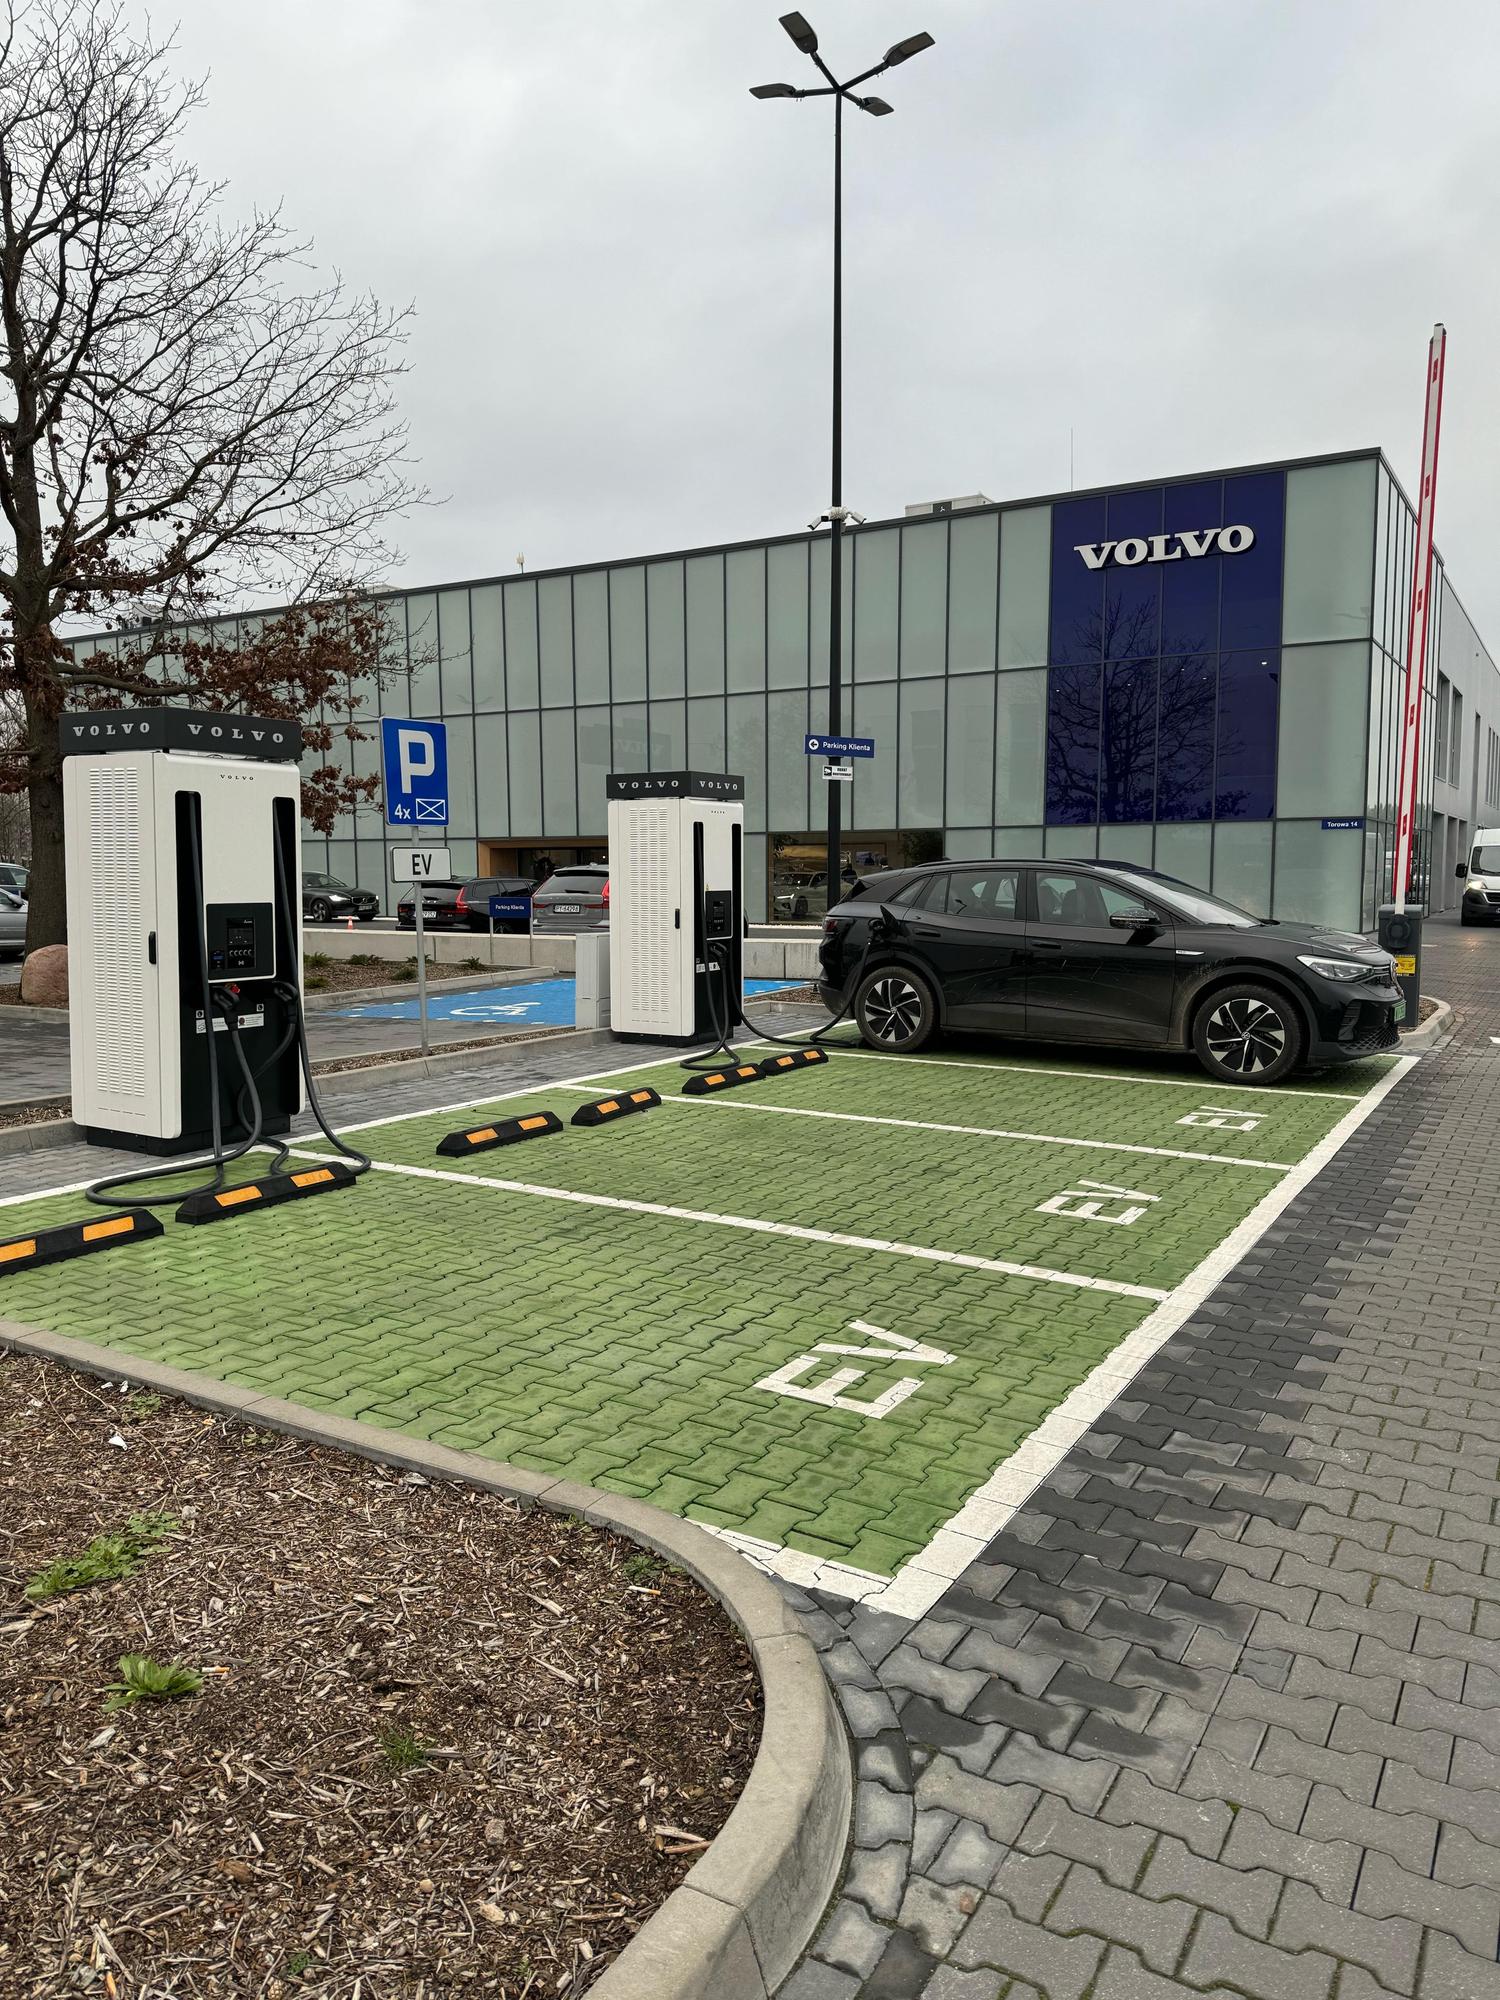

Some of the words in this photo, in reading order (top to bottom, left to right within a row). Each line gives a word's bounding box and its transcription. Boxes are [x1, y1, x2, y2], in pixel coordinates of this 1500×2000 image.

[1074, 525, 1255, 569] VOLVO
[73, 722, 150, 737] VOLVO
[187, 724, 284, 743] VOLVO
[822, 741, 847, 751] Parking
[848, 743, 871, 751] Klienta
[398, 729, 435, 794] P
[618, 780, 679, 789] VOLVO
[699, 780, 738, 791] VOLVO
[394, 803, 411, 820] 4x
[412, 853, 432, 876] EV
[1175, 1105, 1268, 1131] EV
[1034, 1179, 1163, 1226] EV
[753, 1319, 958, 1420] EV
